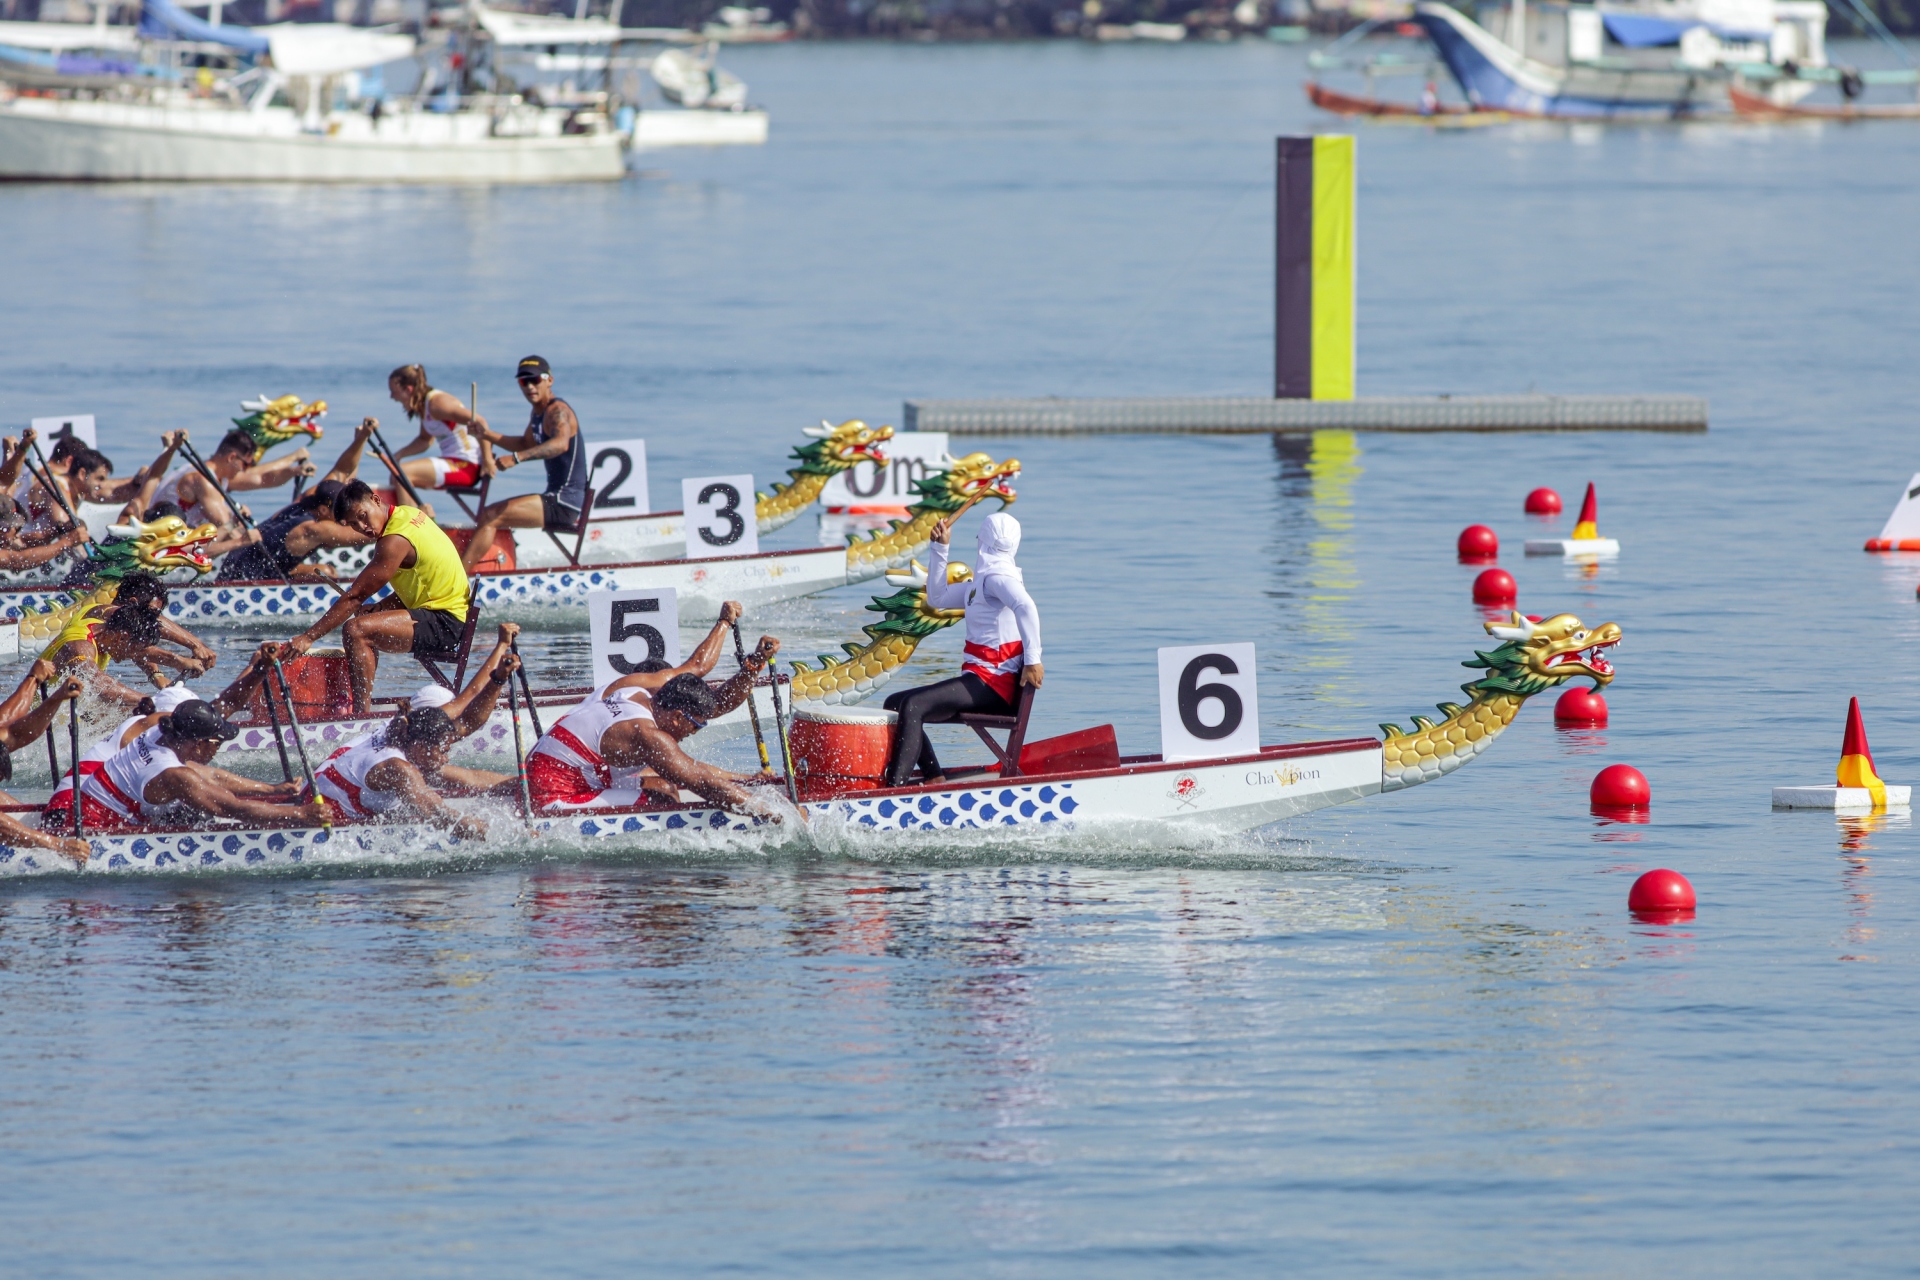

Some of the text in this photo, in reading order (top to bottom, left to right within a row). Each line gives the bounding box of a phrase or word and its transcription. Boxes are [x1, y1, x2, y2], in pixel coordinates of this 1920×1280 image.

[593, 448, 635, 509] 2
[698, 483, 745, 546] 3
[608, 598, 665, 676] 5
[1178, 653, 1243, 741] 6
